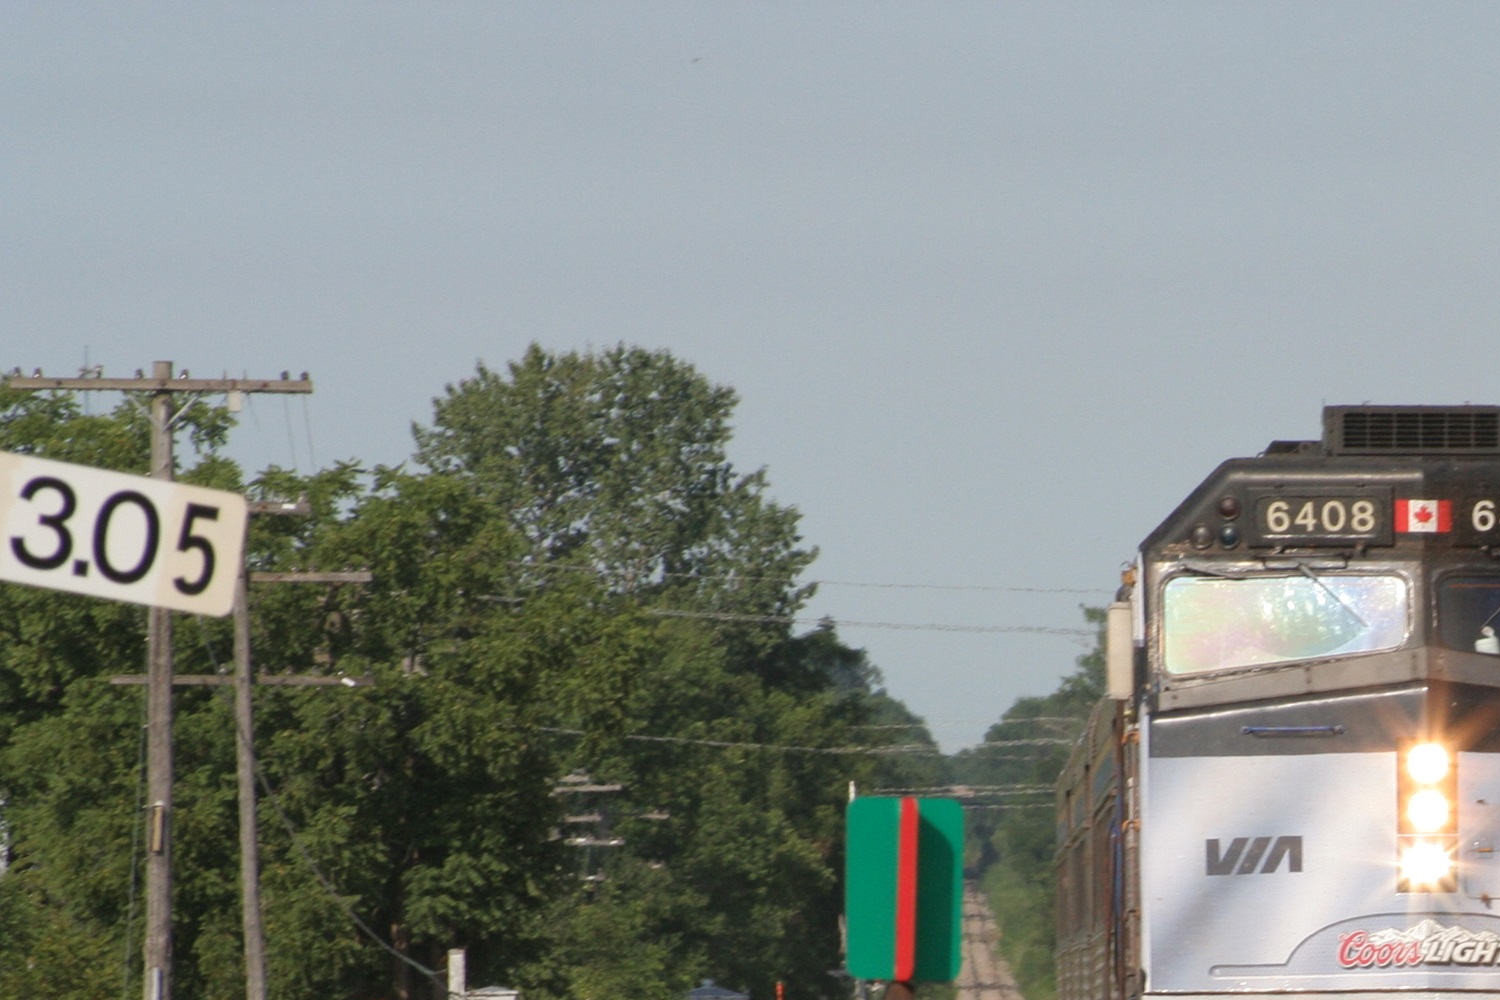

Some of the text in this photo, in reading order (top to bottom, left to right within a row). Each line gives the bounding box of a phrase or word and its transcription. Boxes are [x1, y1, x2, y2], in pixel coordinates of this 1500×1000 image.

[10, 475, 220, 596] 3.05
[1266, 500, 1376, 533] 6408
[1205, 836, 1304, 876] VIA
[1338, 929, 1425, 969] Coors
